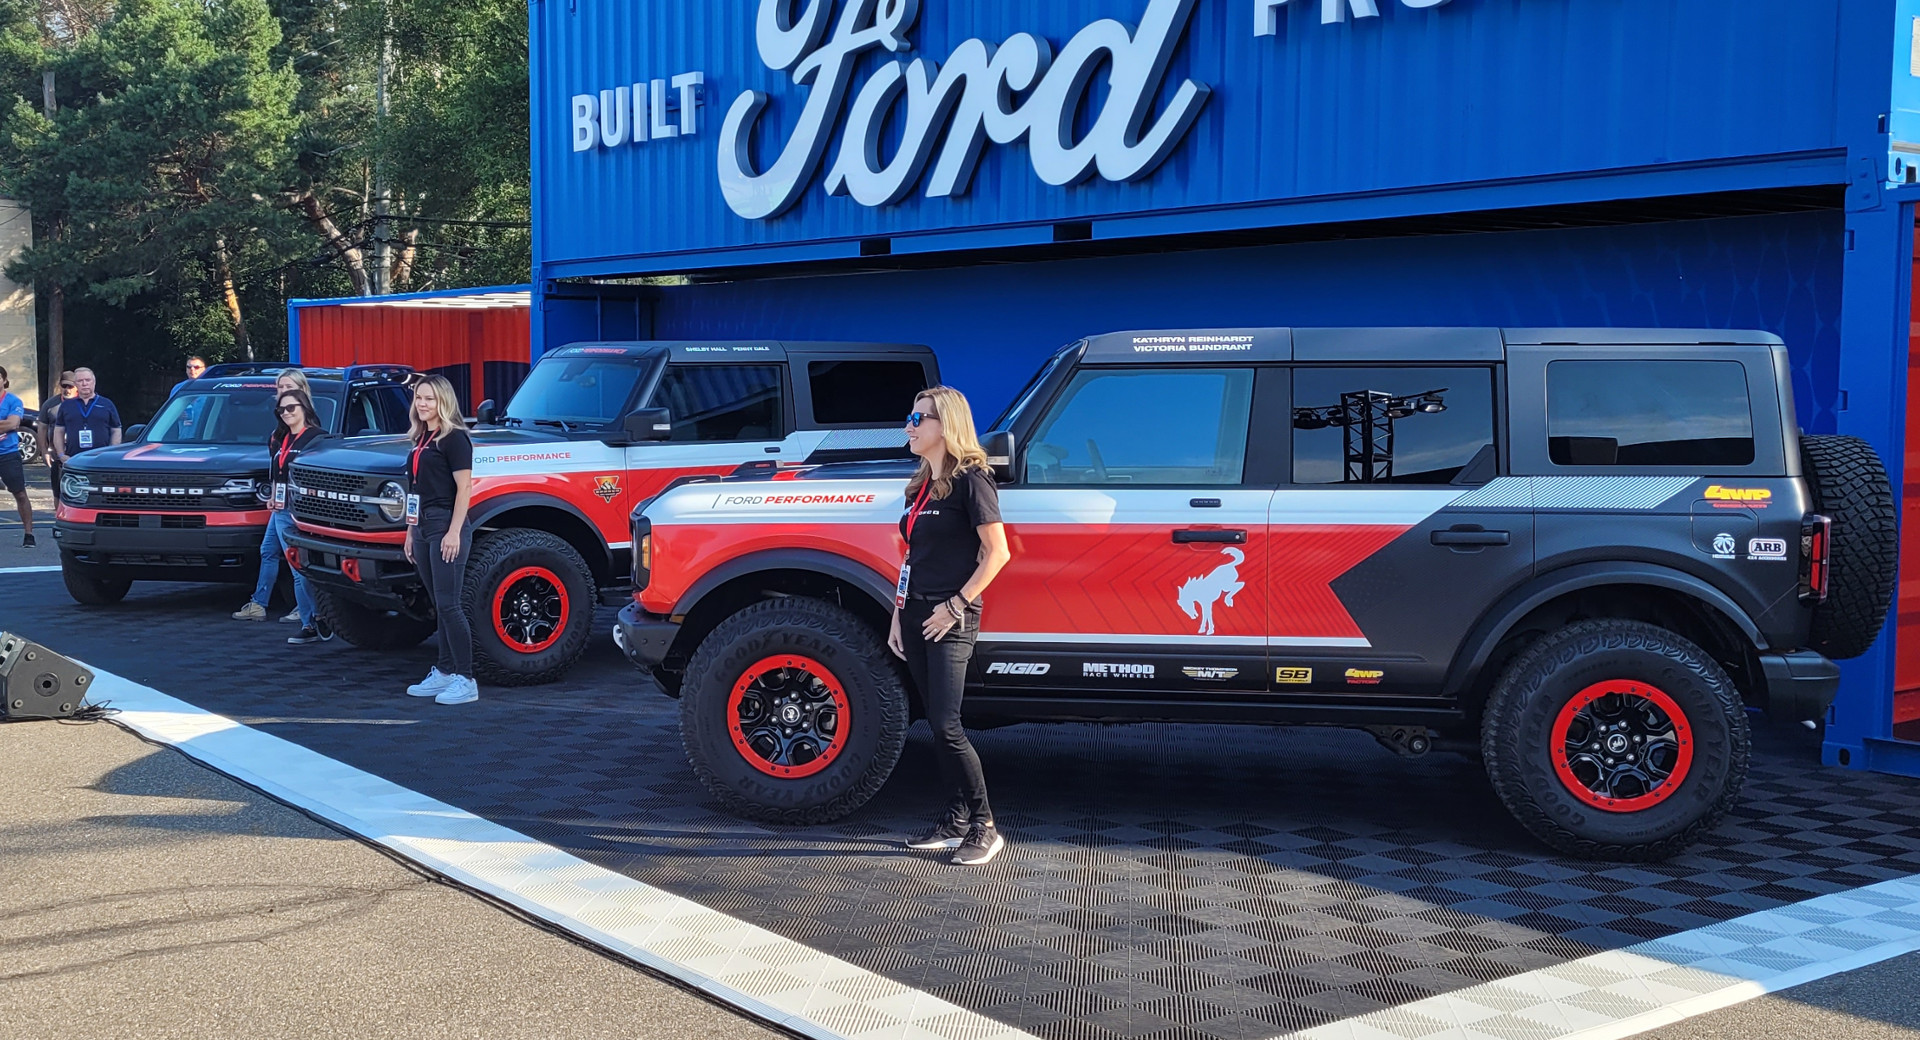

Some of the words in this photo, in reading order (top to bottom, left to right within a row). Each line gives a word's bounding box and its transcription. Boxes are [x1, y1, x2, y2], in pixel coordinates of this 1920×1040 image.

[572, 71, 704, 153] BUILT
[717, 0, 1211, 220] Ford
[1132, 336, 1186, 344] KATHRYN
[1188, 335, 1254, 343] REINHARDT
[1133, 344, 1187, 352] VICTORIA
[1189, 343, 1253, 351] BUNDRANT
[496, 452, 572, 463] PERFORMANCE
[102, 486, 204, 495] BRONCO
[725, 496, 763, 505] FORD
[764, 494, 876, 504] PERFORMANCE
[1754, 542, 1782, 552] ARB
[986, 662, 1051, 675] RIGID
[1082, 662, 1155, 674] METHOD
[1279, 669, 1310, 678] SB
